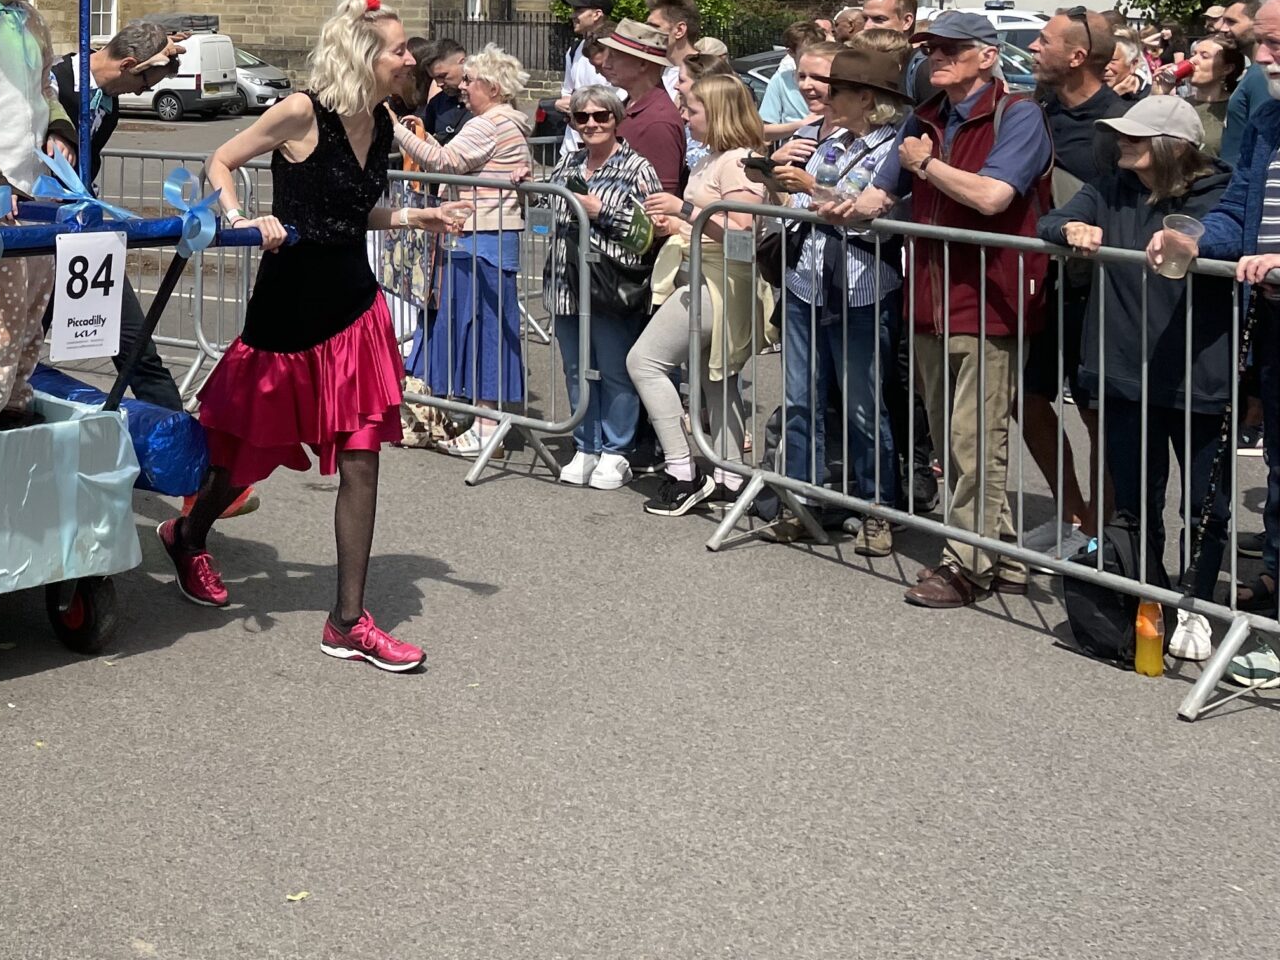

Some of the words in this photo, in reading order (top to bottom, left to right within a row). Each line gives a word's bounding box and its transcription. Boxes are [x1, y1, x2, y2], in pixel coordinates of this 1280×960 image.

[65, 253, 115, 300] 84
[67, 314, 107, 328] Piccadilly
[74, 329, 98, 338] KIA
